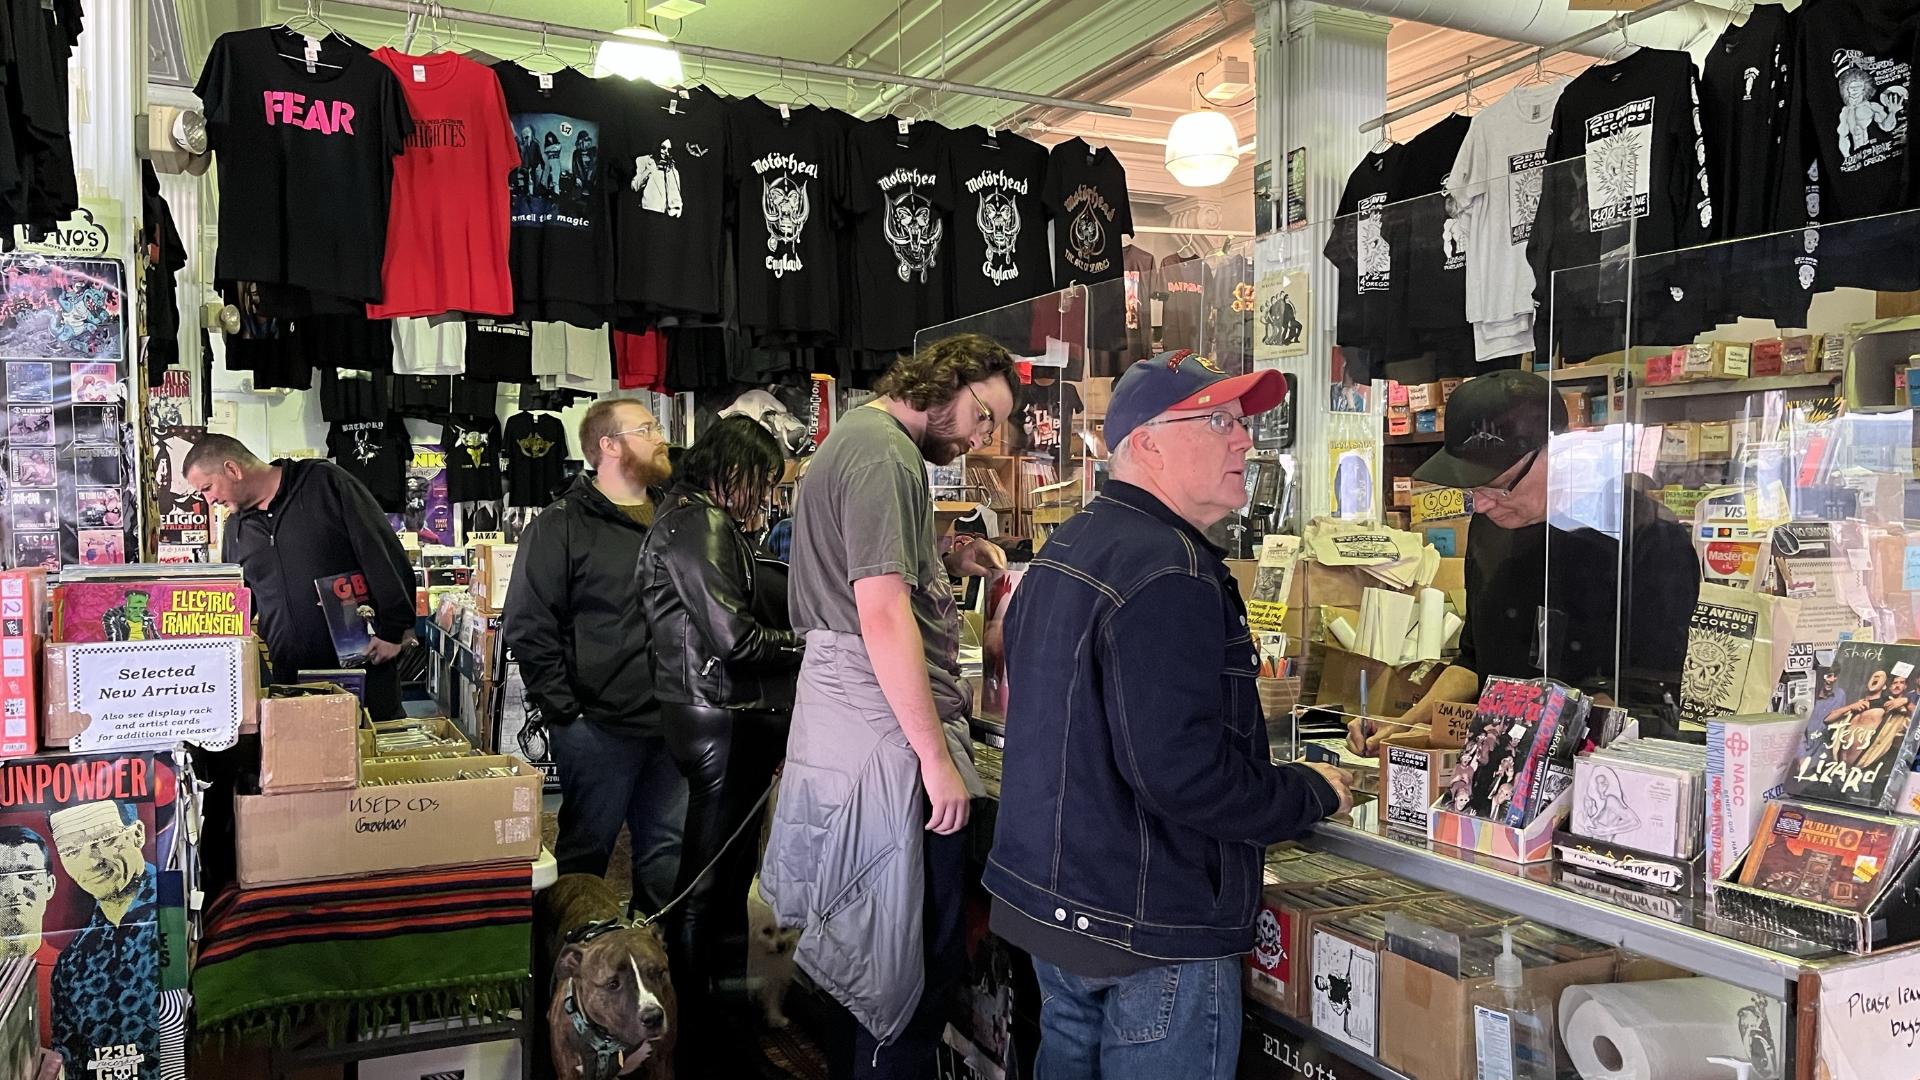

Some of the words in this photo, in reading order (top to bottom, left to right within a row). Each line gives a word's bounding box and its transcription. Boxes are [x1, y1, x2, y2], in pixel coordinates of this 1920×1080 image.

[264, 91, 355, 136] FEAR
[1589, 112, 1615, 130] 2ND
[560, 124, 572, 134] L7
[512, 212, 536, 222] smell
[556, 214, 590, 227] magic
[982, 261, 1019, 286] England
[342, 421, 385, 432] BATHORY
[472, 532, 498, 540] JAZZ
[172, 590, 236, 613] ELECTRIC
[162, 610, 245, 636] FRANKENSTEIN
[1708, 607, 1755, 625] AVENUE
[118, 665, 196, 681] Selected
[99, 687, 137, 700] New
[142, 682, 216, 698] Arrivals
[101, 712, 124, 721] Also
[128, 711, 144, 720] see
[149, 708, 187, 721] display
[189, 706, 213, 716] rack
[1683, 702, 1706, 713] SW
[114, 722, 135, 730] and
[138, 720, 168, 729] artist
[171, 717, 201, 727] cards
[97, 733, 115, 743] for
[116, 729, 173, 740] additional
[175, 726, 217, 737] releases
[1535, 760, 1545, 783] NIGHT
[1530, 782, 1540, 800] ALIVE
[1732, 763, 1745, 807] NACC
[350, 796, 401, 815] USED
[407, 797, 440, 812] CDs
[1803, 820, 1840, 834] PUBLIC
[1799, 832, 1838, 847] ENEMY
[1847, 992, 1890, 1019] Please
[1263, 1033, 1337, 1080] Elliott
